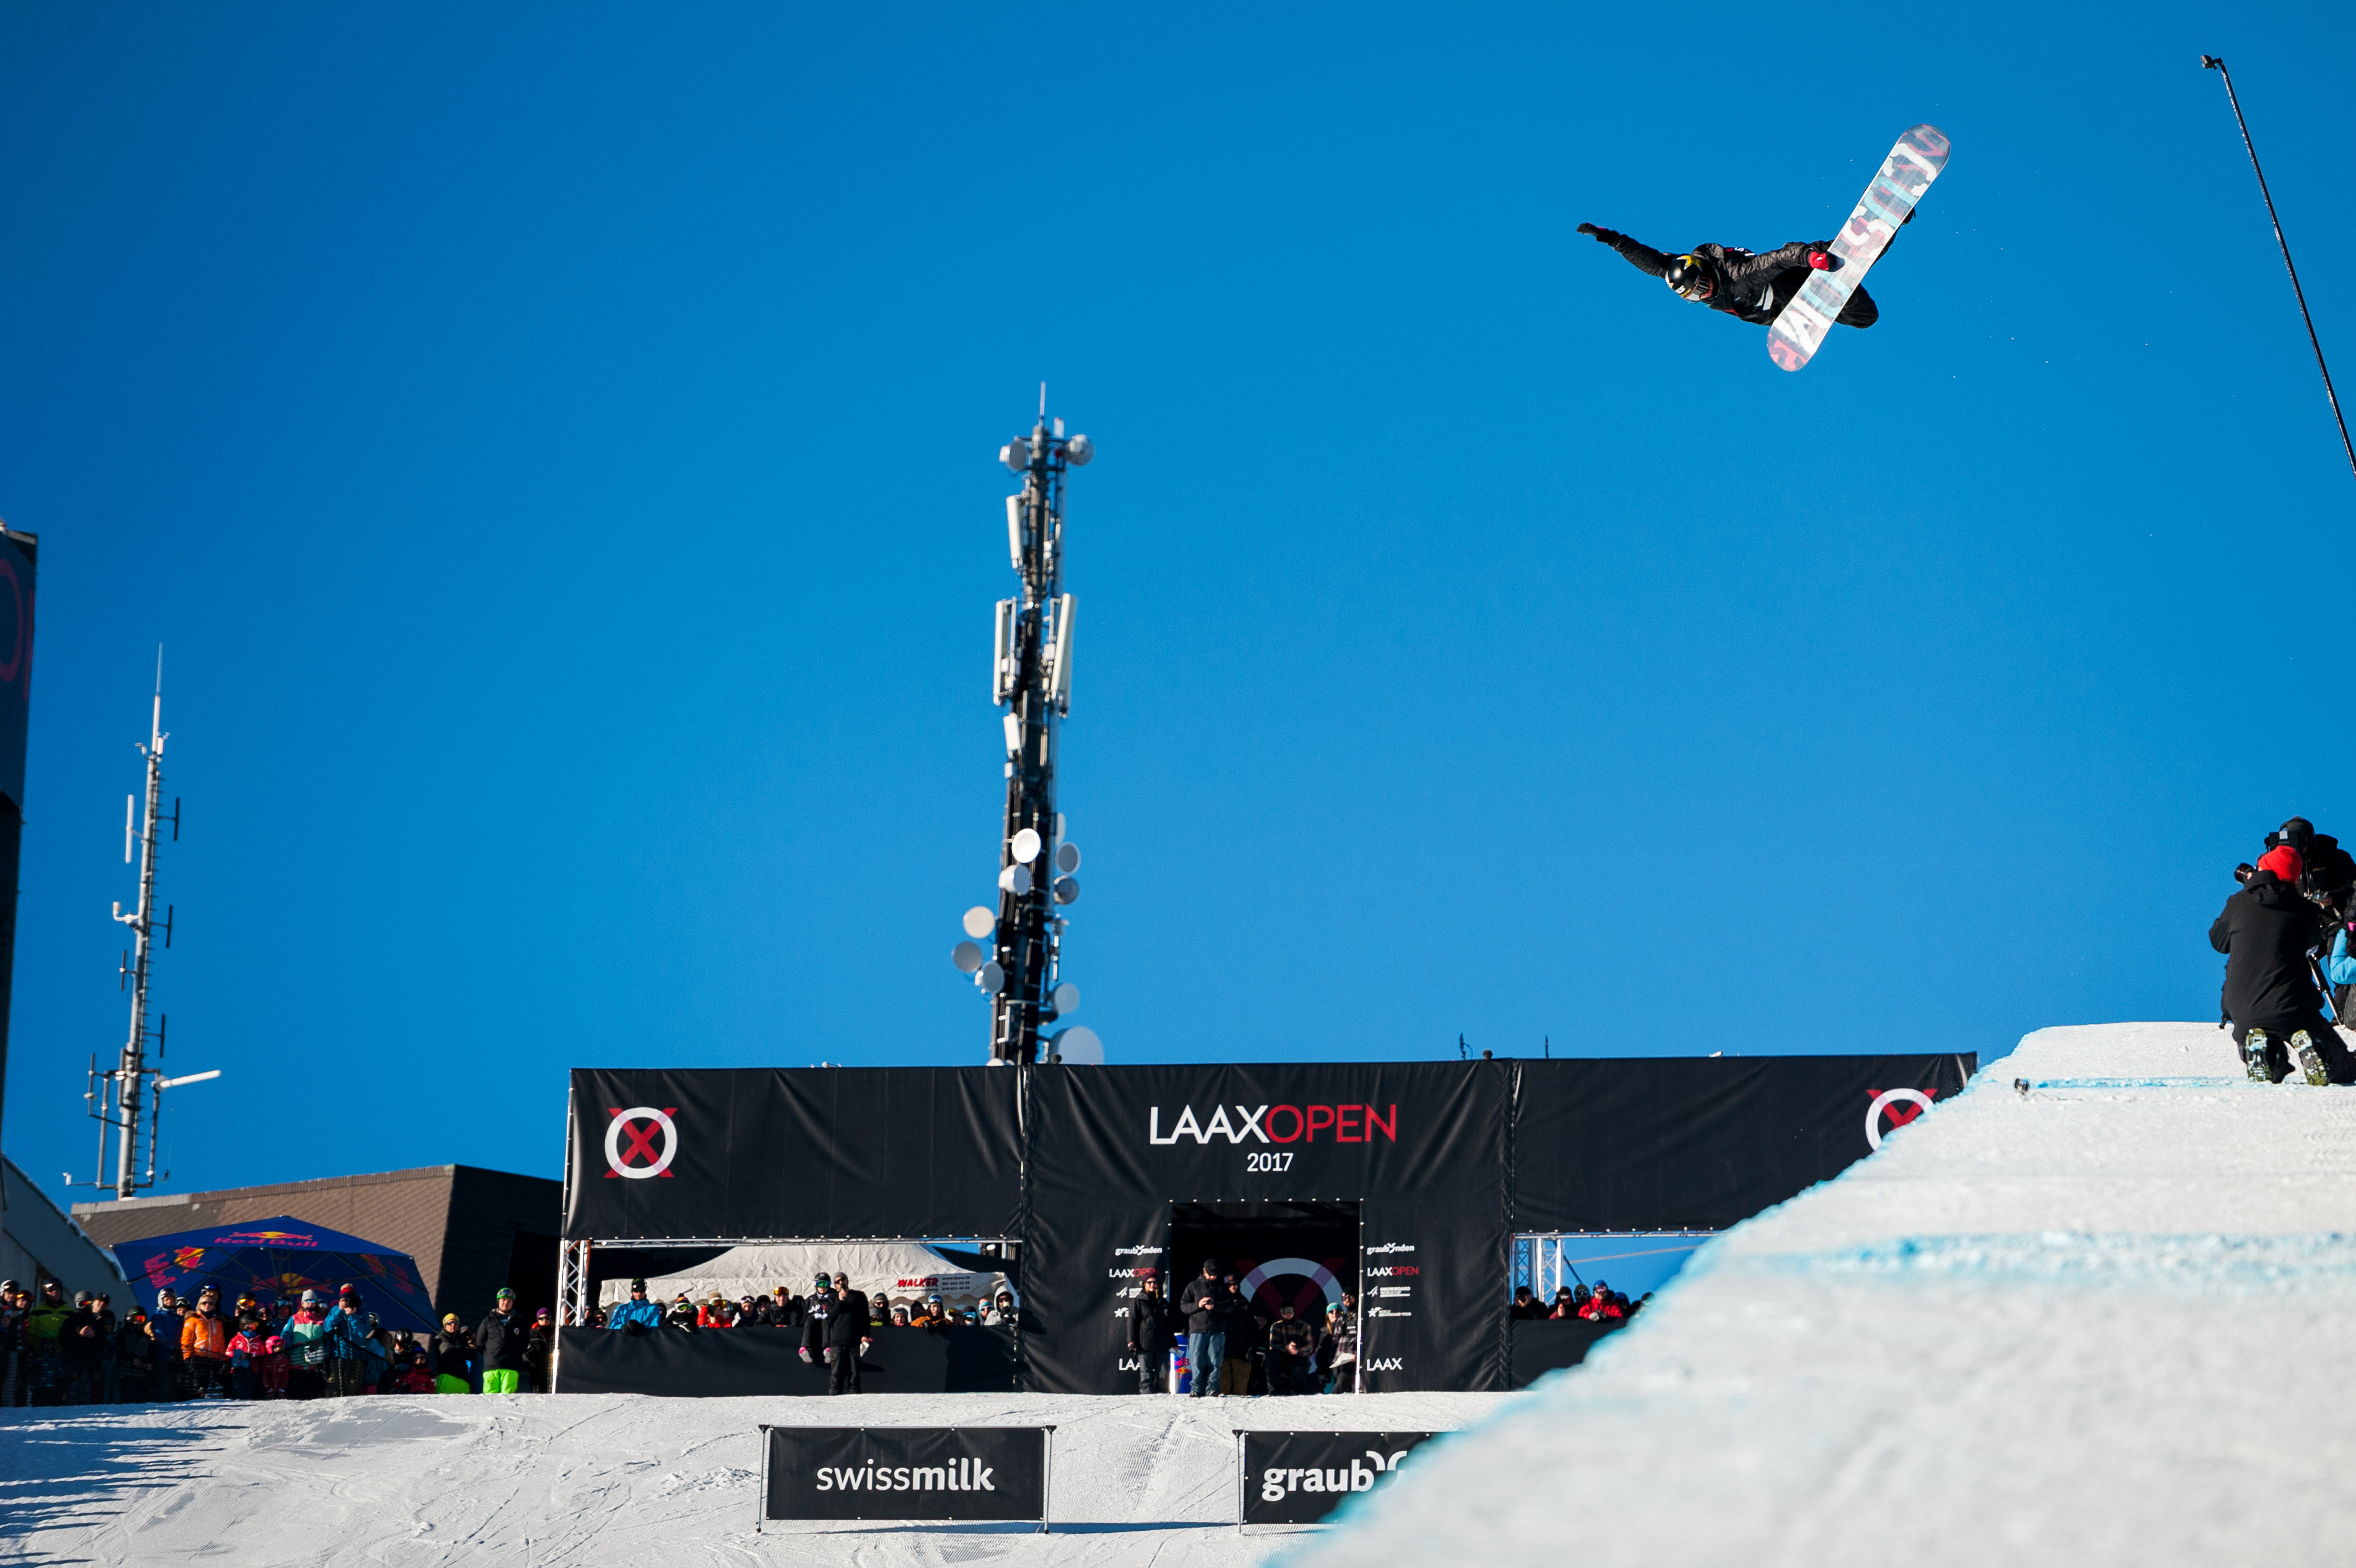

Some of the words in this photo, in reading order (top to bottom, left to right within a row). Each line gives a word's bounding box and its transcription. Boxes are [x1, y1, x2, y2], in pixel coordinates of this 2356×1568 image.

[1247, 1152, 1293, 1172] 2017
[268, 1239, 319, 1247] Bull
[897, 1277, 938, 1288] WALKER
[1367, 1357, 1402, 1371] LAAX
[817, 1458, 995, 1491] swissmilk
